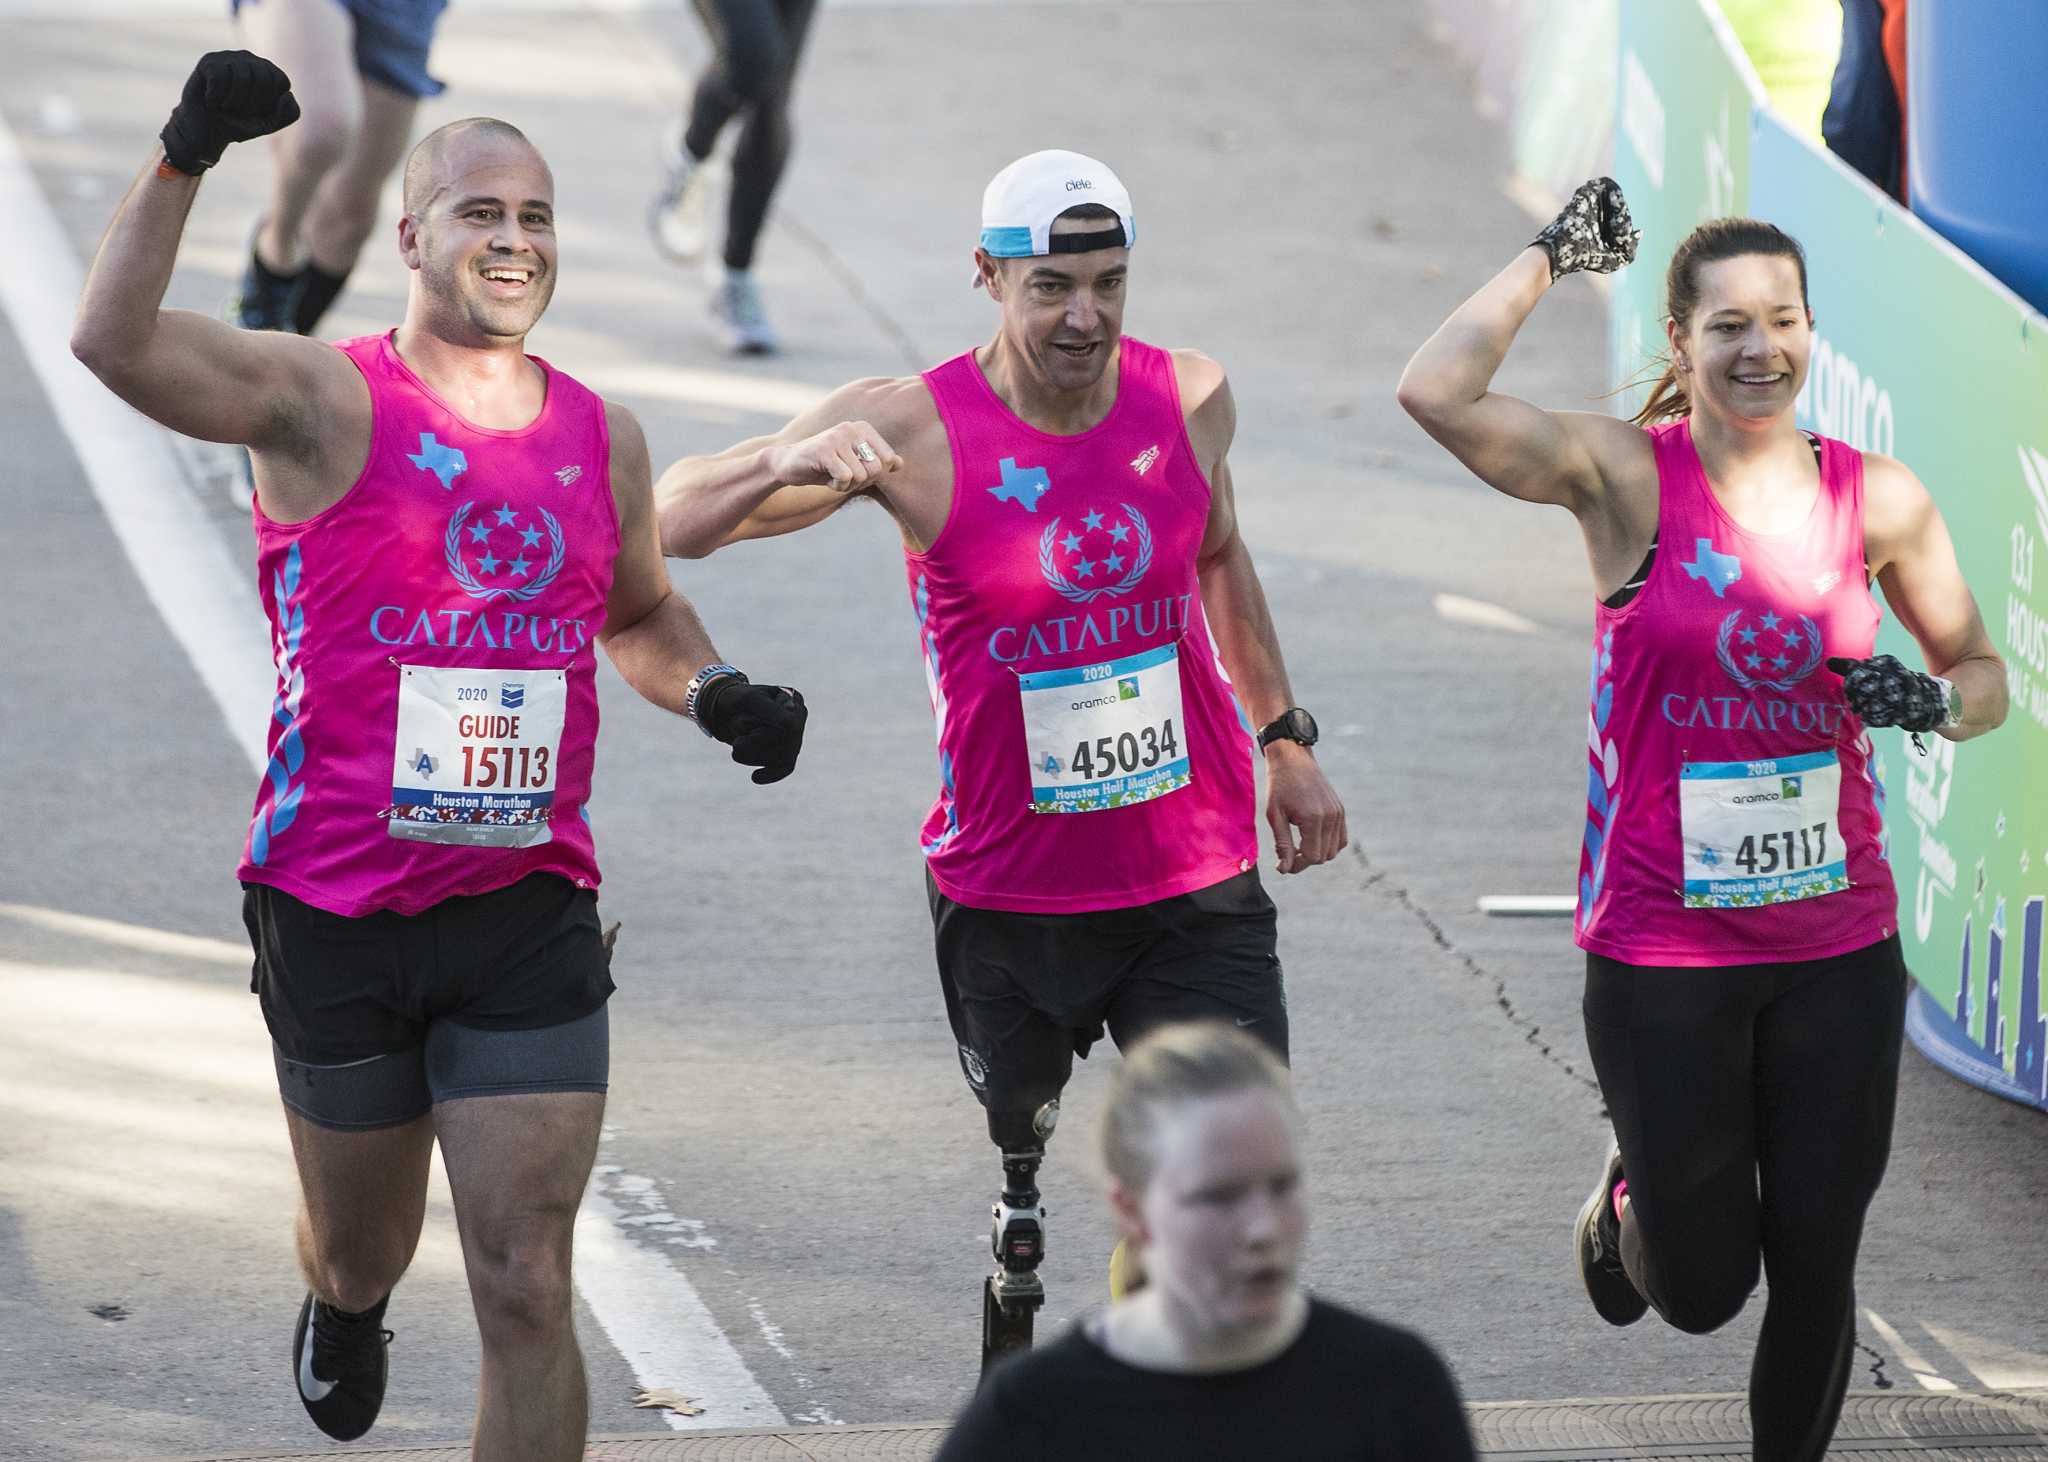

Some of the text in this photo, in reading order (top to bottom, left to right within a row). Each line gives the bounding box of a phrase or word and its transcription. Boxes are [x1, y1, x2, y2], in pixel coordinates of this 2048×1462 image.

[369, 605, 587, 654] CATAPULT
[988, 593, 1192, 663] CATAPULT
[1083, 664, 1112, 681] 2020
[457, 687, 488, 701] 2020
[1071, 695, 1117, 711] aramco
[1662, 692, 1847, 734] CATAPULT
[459, 714, 520, 739] GUIDE
[1071, 718, 1177, 780] 45034
[416, 753, 434, 774] A
[462, 746, 549, 788] 15113
[1044, 755, 1061, 773] A
[1747, 761, 1777, 776] 2020
[1055, 769, 1172, 800] Houston Half Marathon
[433, 793, 531, 809] Houston Marathon
[1732, 792, 1780, 804] aramco
[1735, 822, 1827, 875] 45117
[1709, 870, 1829, 895] Houston Half Marathon
